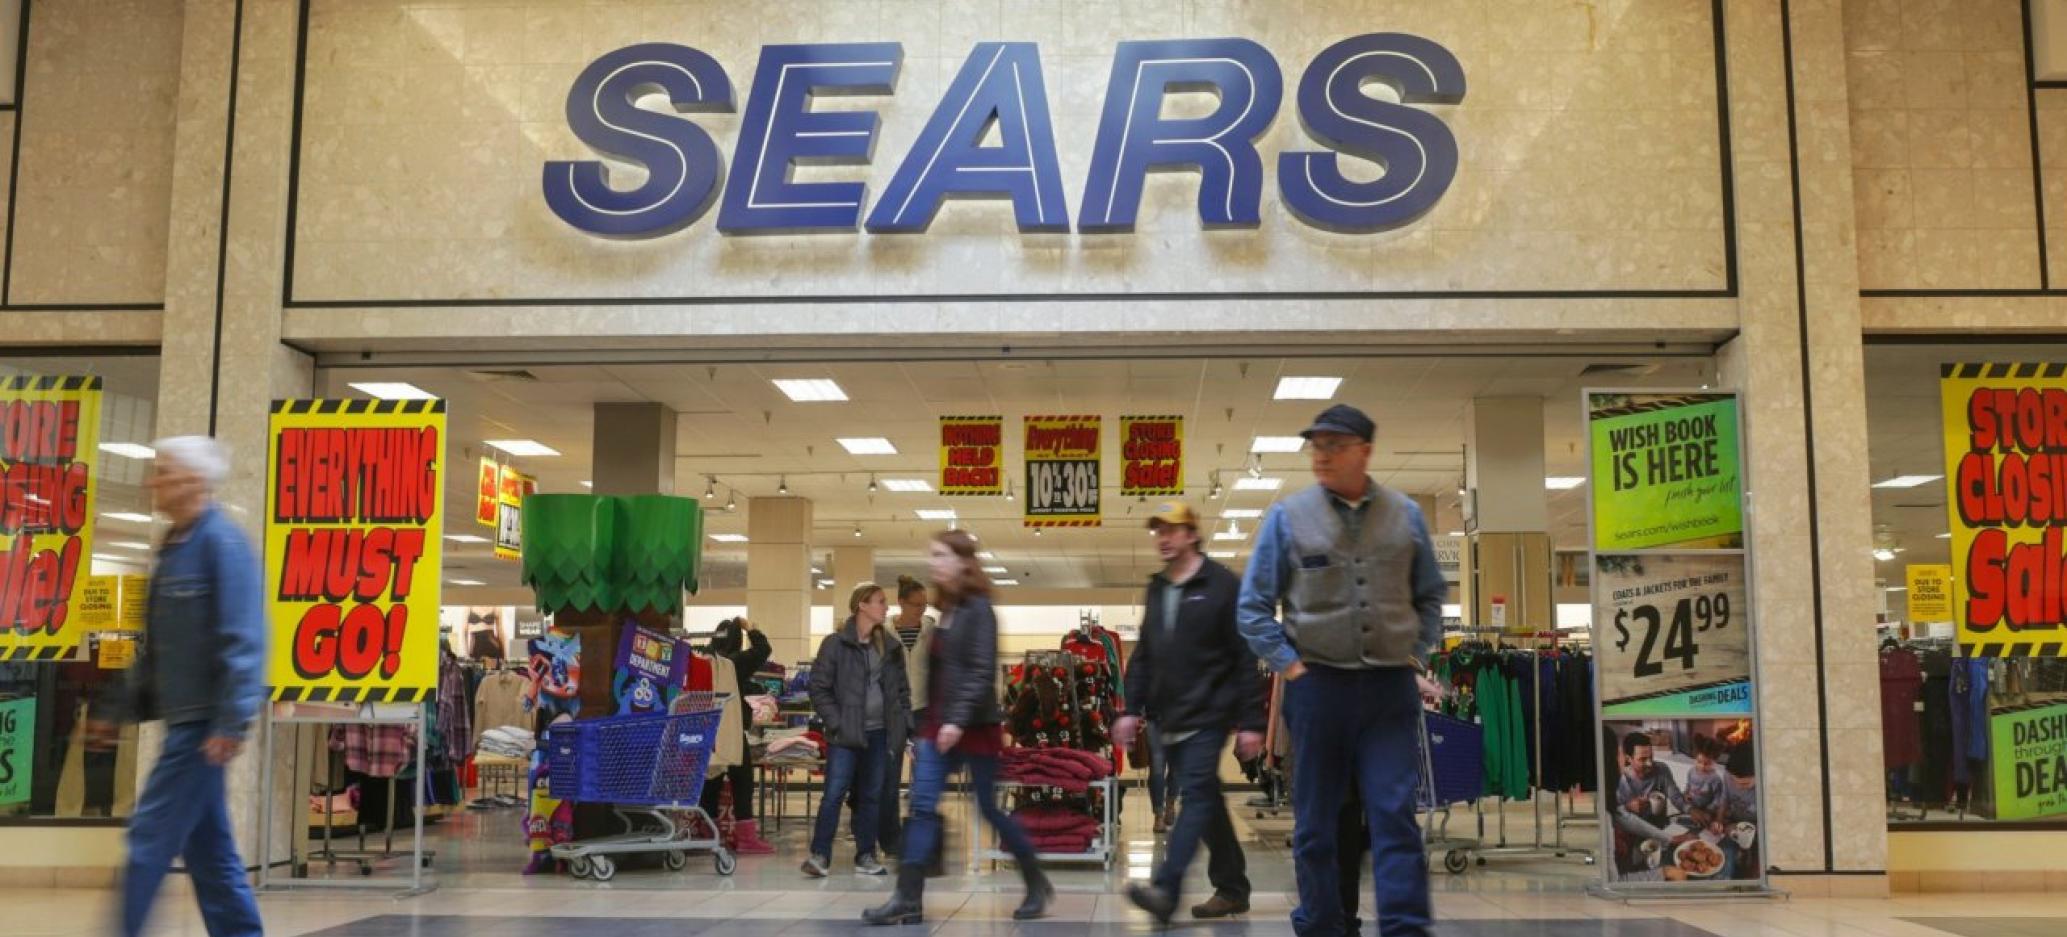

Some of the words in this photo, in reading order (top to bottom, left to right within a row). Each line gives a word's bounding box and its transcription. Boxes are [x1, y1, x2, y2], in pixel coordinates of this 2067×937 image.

[543, 32, 1466, 239] SEARS
[0, 399, 80, 465] ORE
[1124, 439, 1181, 461] CLOSING
[1609, 423, 1659, 453] WISH
[1664, 414, 1717, 443] BOOK
[275, 425, 437, 525] EVERYTHING
[948, 447, 995, 466] HELD
[1124, 459, 1180, 489] Sale!
[1612, 452, 1639, 492] IS
[1648, 439, 1719, 486] HERE
[1615, 514, 1719, 541] sears.com/wishbook
[278, 527, 425, 602] MUST
[1965, 526, 2067, 633] Sal
[1612, 588, 1634, 601] COATS
[1643, 581, 1672, 596] JACKETS
[1673, 579, 1687, 591] FOR
[1703, 572, 1728, 584] FAMILY
[292, 603, 407, 680] GO!
[629, 653, 671, 678] DEPARTMENT
[1717, 685, 1748, 704] DEALS
